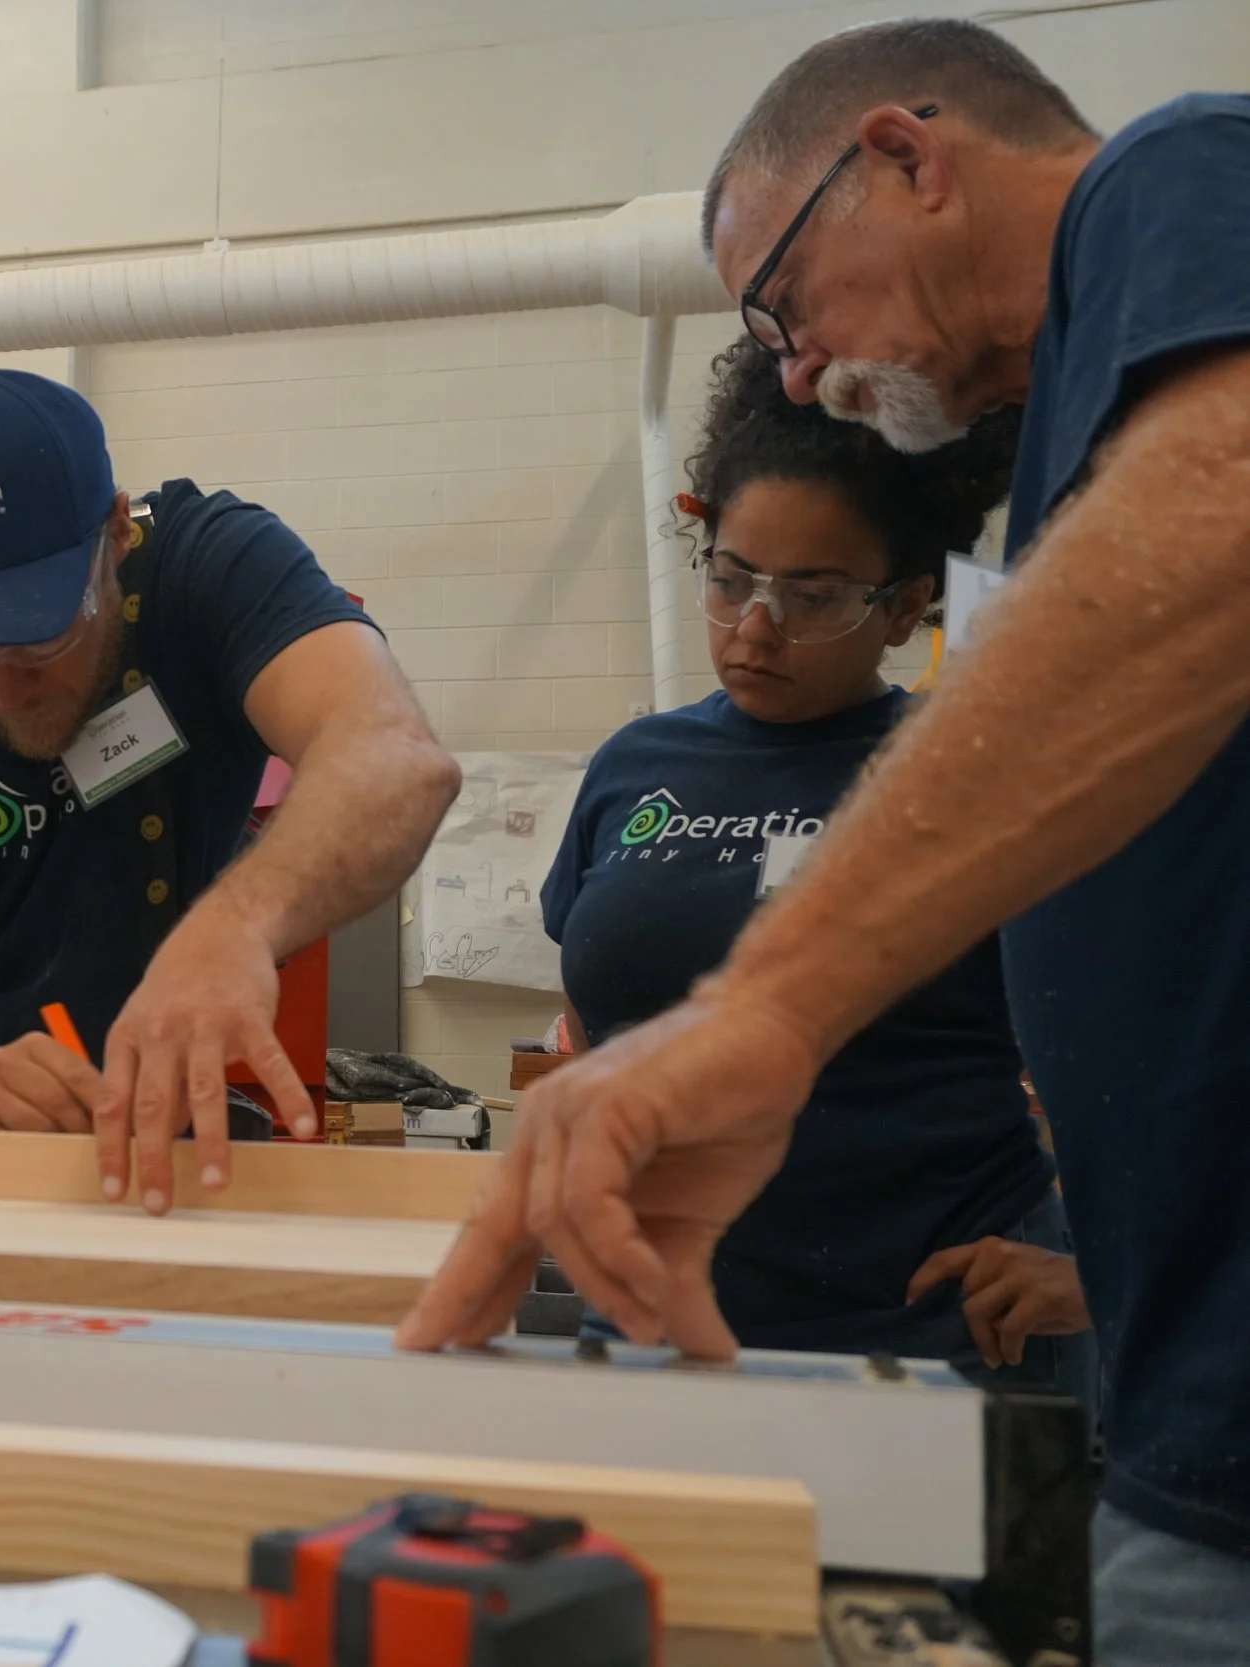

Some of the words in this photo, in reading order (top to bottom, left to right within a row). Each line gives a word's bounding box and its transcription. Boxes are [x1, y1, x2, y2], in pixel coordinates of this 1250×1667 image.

[100, 734, 140, 763] Zack
[620, 801, 824, 845] Operatio
[606, 847, 679, 864] Tiny
[717, 848, 766, 863] Ho
